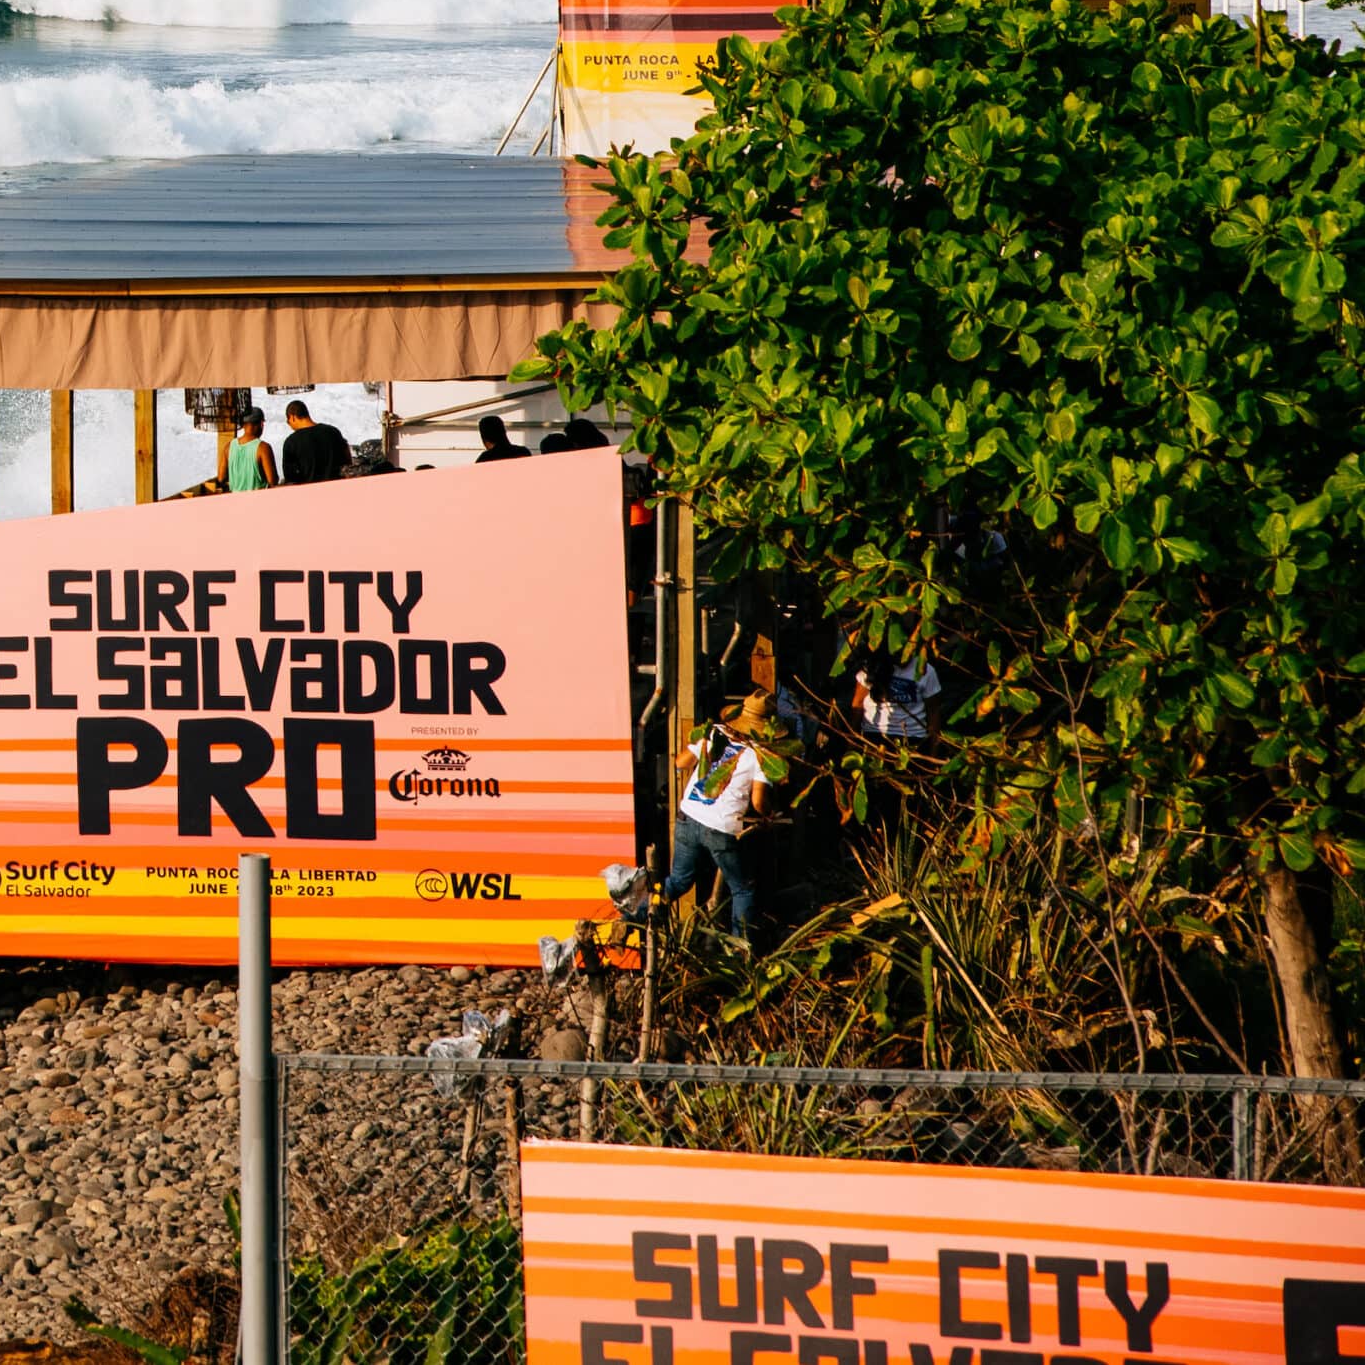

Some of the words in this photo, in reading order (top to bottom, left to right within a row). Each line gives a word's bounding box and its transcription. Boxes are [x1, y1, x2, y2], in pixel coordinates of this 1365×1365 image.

[584, 55, 631, 65] PUNTA
[639, 55, 679, 65] ROCA
[623, 70, 658, 80] JUNE
[48, 570, 235, 632] SURF
[259, 570, 423, 634] CITY
[411, 727, 465, 735] PRESENTED
[467, 728, 479, 736] BY
[77, 717, 377, 840] PRO
[388, 768, 501, 805] Corona
[5, 861, 59, 881] Surf
[64, 861, 115, 885] City
[146, 867, 198, 878] PUNTA
[207, 868, 239, 879] ROC
[270, 869, 290, 880] LA
[299, 869, 377, 882] LIBERTAD
[6, 885, 20, 897] El
[25, 884, 91, 898] Salvador
[188, 884, 228, 894] JUNE
[297, 886, 334, 896] 2023
[450, 873, 522, 900] WSL
[632, 1231, 888, 1331] SURF
[938, 1249, 1170, 1353] CITY
